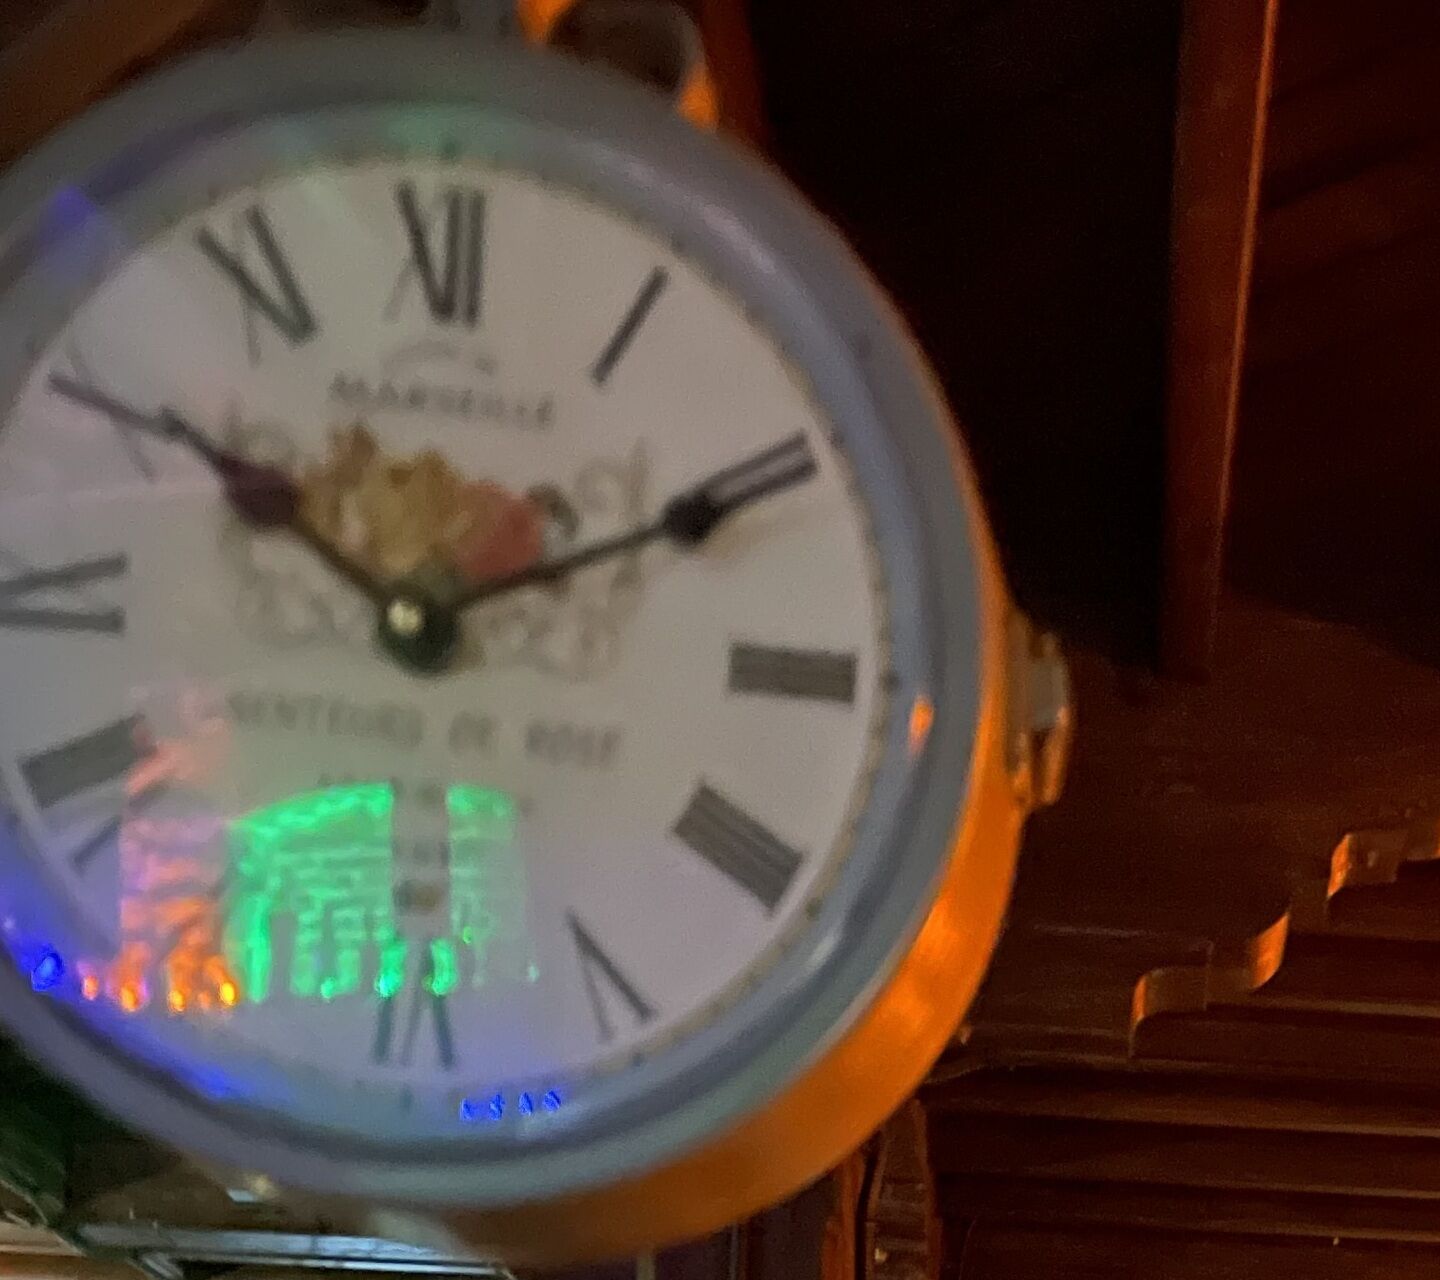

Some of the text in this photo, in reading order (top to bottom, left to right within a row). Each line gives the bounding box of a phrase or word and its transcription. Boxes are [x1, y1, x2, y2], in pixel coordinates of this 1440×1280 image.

[195, 204, 320, 368] XI
[382, 177, 488, 330] XII
[591, 264, 670, 387] I
